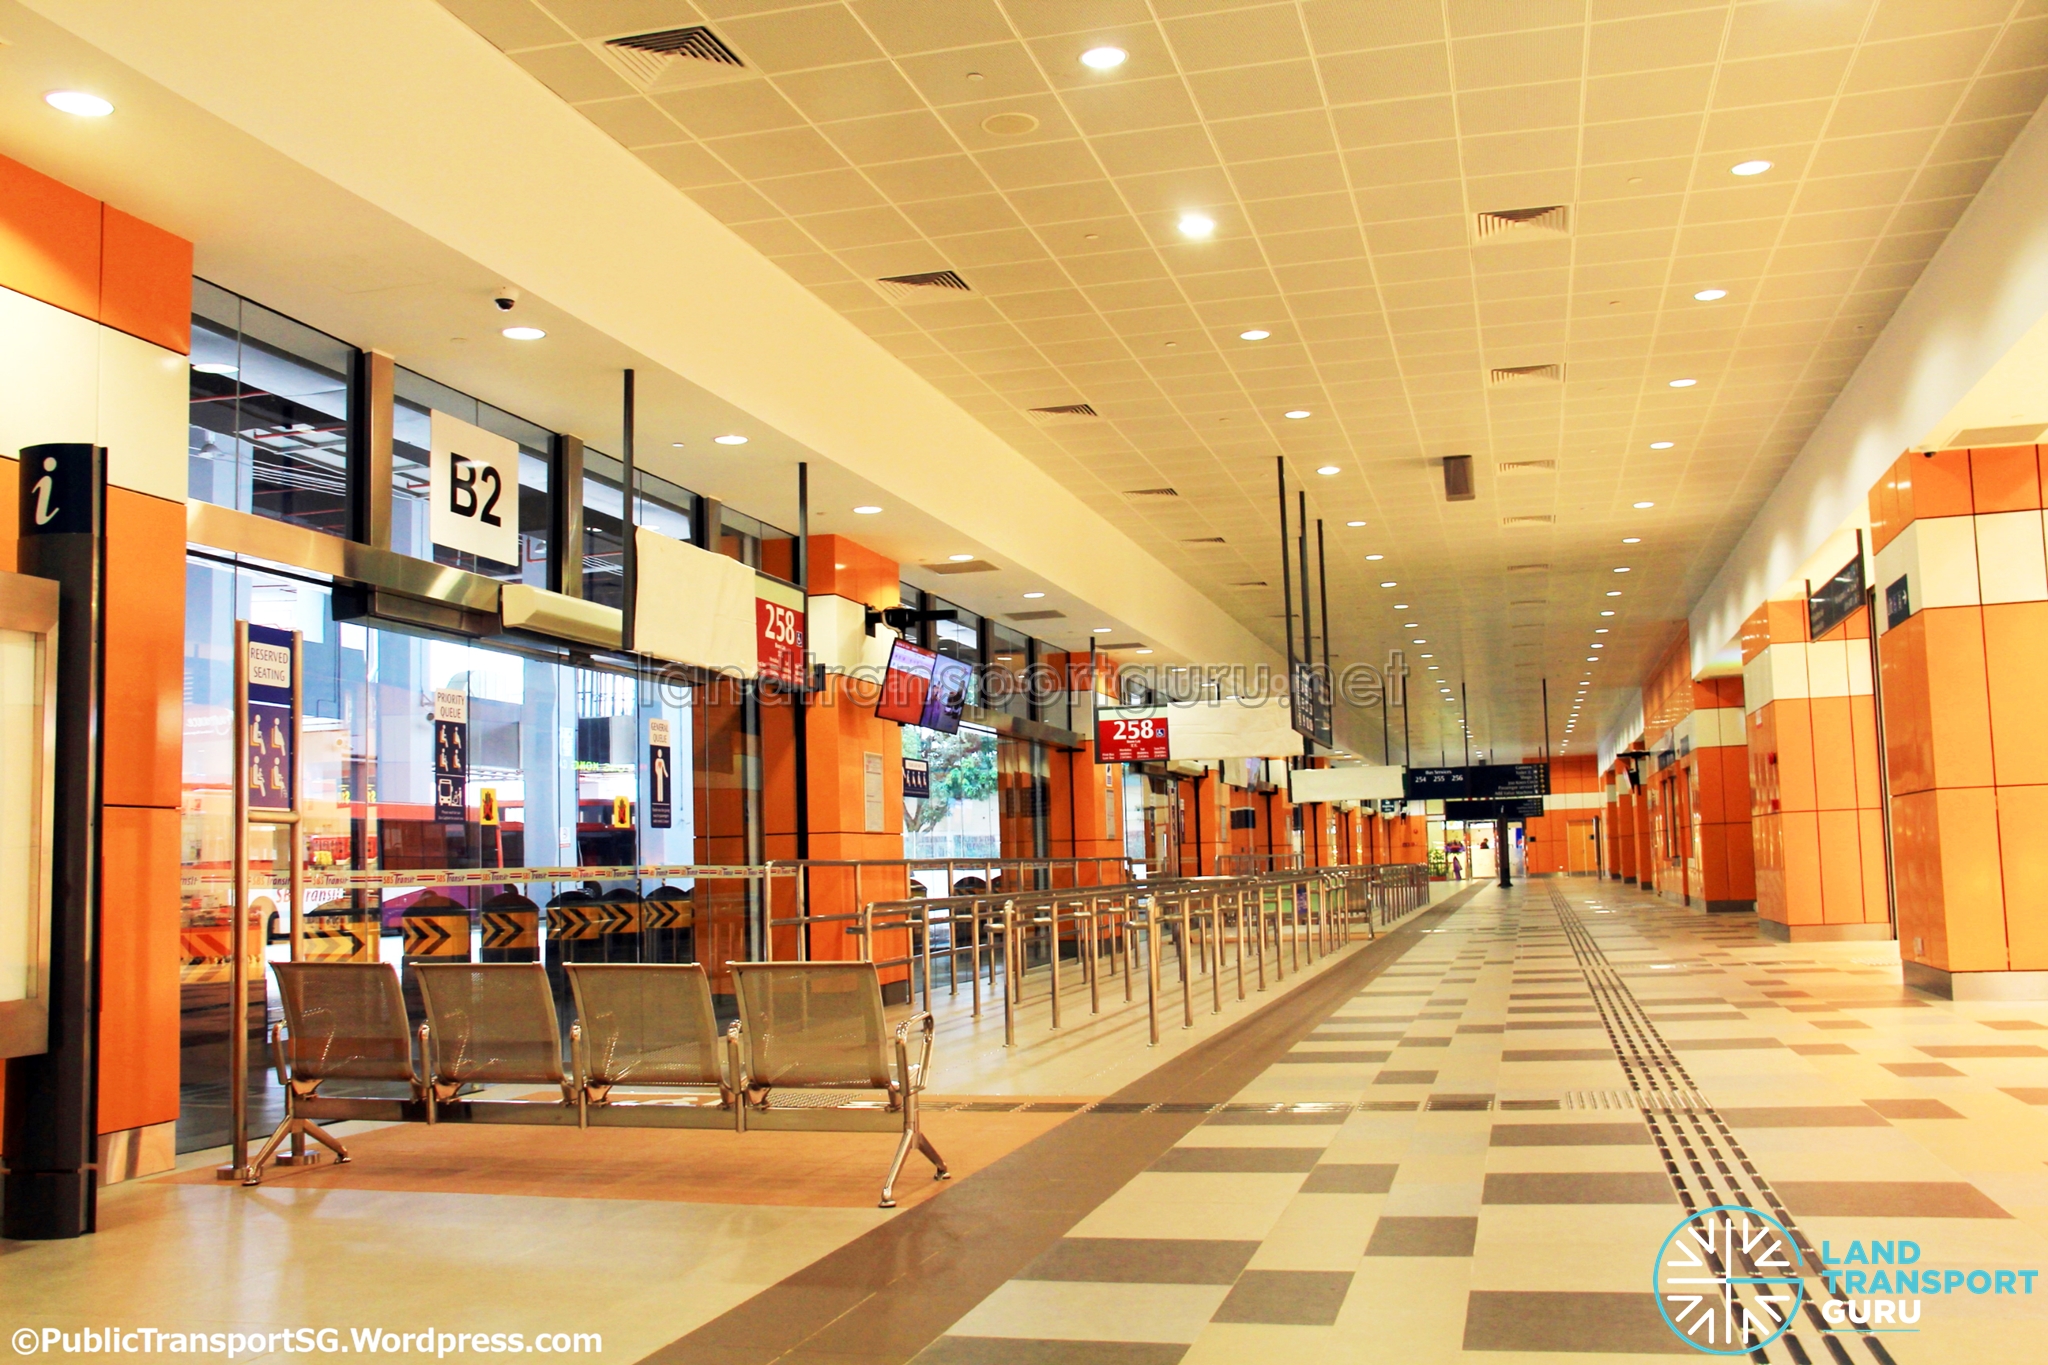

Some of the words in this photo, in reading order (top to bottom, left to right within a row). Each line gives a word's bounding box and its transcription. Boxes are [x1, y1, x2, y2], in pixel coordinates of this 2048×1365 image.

[450, 452, 502, 528] B2
[765, 603, 796, 645] 258
[250, 647, 288, 665] RESERVED
[253, 665, 285, 682] SEATING
[437, 692, 465, 706] PRIORITY
[440, 706, 461, 719] QUEUE
[650, 721, 669, 733] GENERAL
[1113, 719, 1155, 740] 258
[652, 733, 667, 743] QUEUE
[324, 873, 349, 886] Transit
[383, 876, 394, 885] SBS
[394, 873, 416, 884] Transit
[436, 874, 446, 883] SBS
[446, 872, 465, 883] Transit
[482, 873, 491, 882] SBS
[490, 871, 509, 881] Transit
[277, 888, 290, 903] SB
[305, 888, 340, 902] ransit
